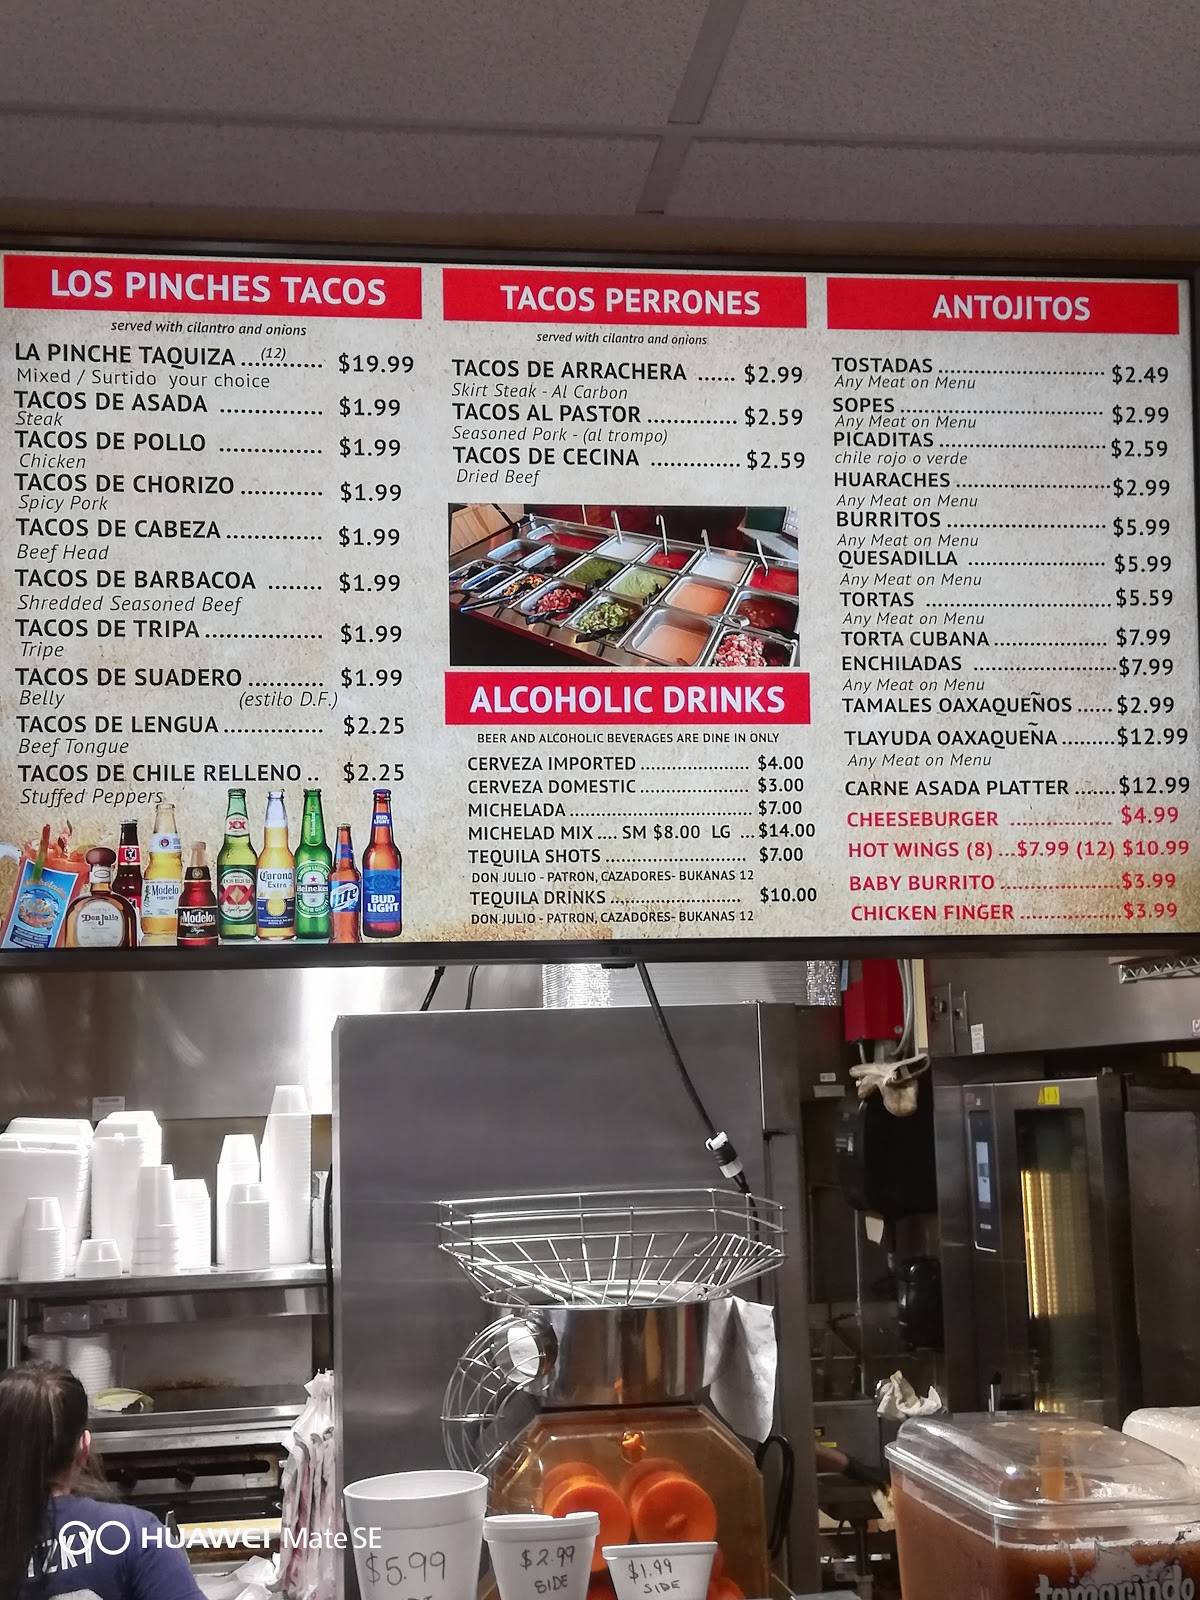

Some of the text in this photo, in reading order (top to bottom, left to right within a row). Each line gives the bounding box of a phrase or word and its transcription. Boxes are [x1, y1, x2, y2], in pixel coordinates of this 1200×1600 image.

[52, 270, 385, 305] LOS PINCHES TACOS
[500, 286, 760, 315] TACOS PERRONES
[933, 295, 1090, 320] ANTOJITOS
[111, 320, 306, 336] served with cilantro and onions
[16, 343, 413, 374] LA PINCHE TAQUIZA (12) $19.99
[18, 368, 70, 383] Mixed
[92, 370, 156, 385] Surtido
[169, 375, 207, 389] your
[215, 373, 269, 388] choice
[452, 359, 802, 385] TACOS DE ARRACHERA $2.99
[832, 357, 1168, 385] TOSTADAS $2.49
[452, 383, 488, 397] Skirt
[494, 382, 536, 398] Steak
[551, 384, 567, 398] Al
[574, 385, 627, 399] Carbon
[834, 375, 975, 391] Any Meat on Menu
[14, 390, 400, 417] TACOS DE ASADA $1.99
[16, 411, 63, 426] Steak
[452, 426, 526, 440] Seasoned
[533, 427, 567, 441] Pork
[583, 428, 601, 445] (al
[609, 429, 667, 446] trompo)
[834, 432, 1167, 459] PICADITAS $2.59
[835, 451, 967, 467] chile rojo o verde
[457, 469, 541, 487] Dried Beef
[18, 494, 108, 513] Spicy Pork
[16, 518, 399, 547] TACOS DE CABEZA $1.99
[837, 511, 1170, 538] BURRITOS $5.99
[17, 544, 109, 563] Beef Head
[17, 595, 243, 616] Shredded Seasoned Beef
[841, 627, 1170, 648] TORTA CUBANA $7.99
[842, 656, 1173, 678] ENCHILADAS $7.99
[15, 667, 402, 688] TACOS DE SUADERO $1.99
[20, 690, 65, 709] Belly
[240, 691, 337, 710] (estilo D.F.)
[470, 686, 784, 713] ALCOHOLIC DRINKS
[478, 731, 779, 743] BEER AND ALCOHOLIC BEVERAGES ARE DINE IN ONLY
[844, 722, 1188, 749] TLAYUDA OAXAQUEÑA $12.99
[18, 762, 404, 784] TACOS DE CHILE RELLENO $2.25
[468, 755, 803, 772] CERVEZA IMPORTED $4.00
[845, 775, 1189, 796] CARNE ASADA PLATTER $12.99
[20, 788, 165, 810] Stuffed Peppers
[469, 800, 802, 817] MICHELADA $7.00
[848, 807, 1178, 827] CHEESEBURGER $4.99
[469, 822, 815, 841] MICHELAD MIX SM $8.00 LG $14.00
[848, 840, 1188, 860] HOT WINGS (8) $7.99 (12) $10.99
[472, 872, 498, 883] DON
[502, 872, 536, 882] JULIO
[680, 870, 738, 880] BUKANAS
[740, 870, 753, 880] 12
[152, 885, 178, 896] Modelo
[371, 895, 395, 904] BUD
[182, 911, 213, 923] Modelo
[368, 902, 399, 912] LIGHT
[852, 902, 1176, 920] CHICKEN FINGER $3.99
[520, 1545, 576, 1571] $2.99
[366, 1552, 445, 1586] $5.99
[628, 1559, 672, 1584] $1.99
[534, 1574, 569, 1594] SIDE
[643, 1579, 681, 1594] SIDE
